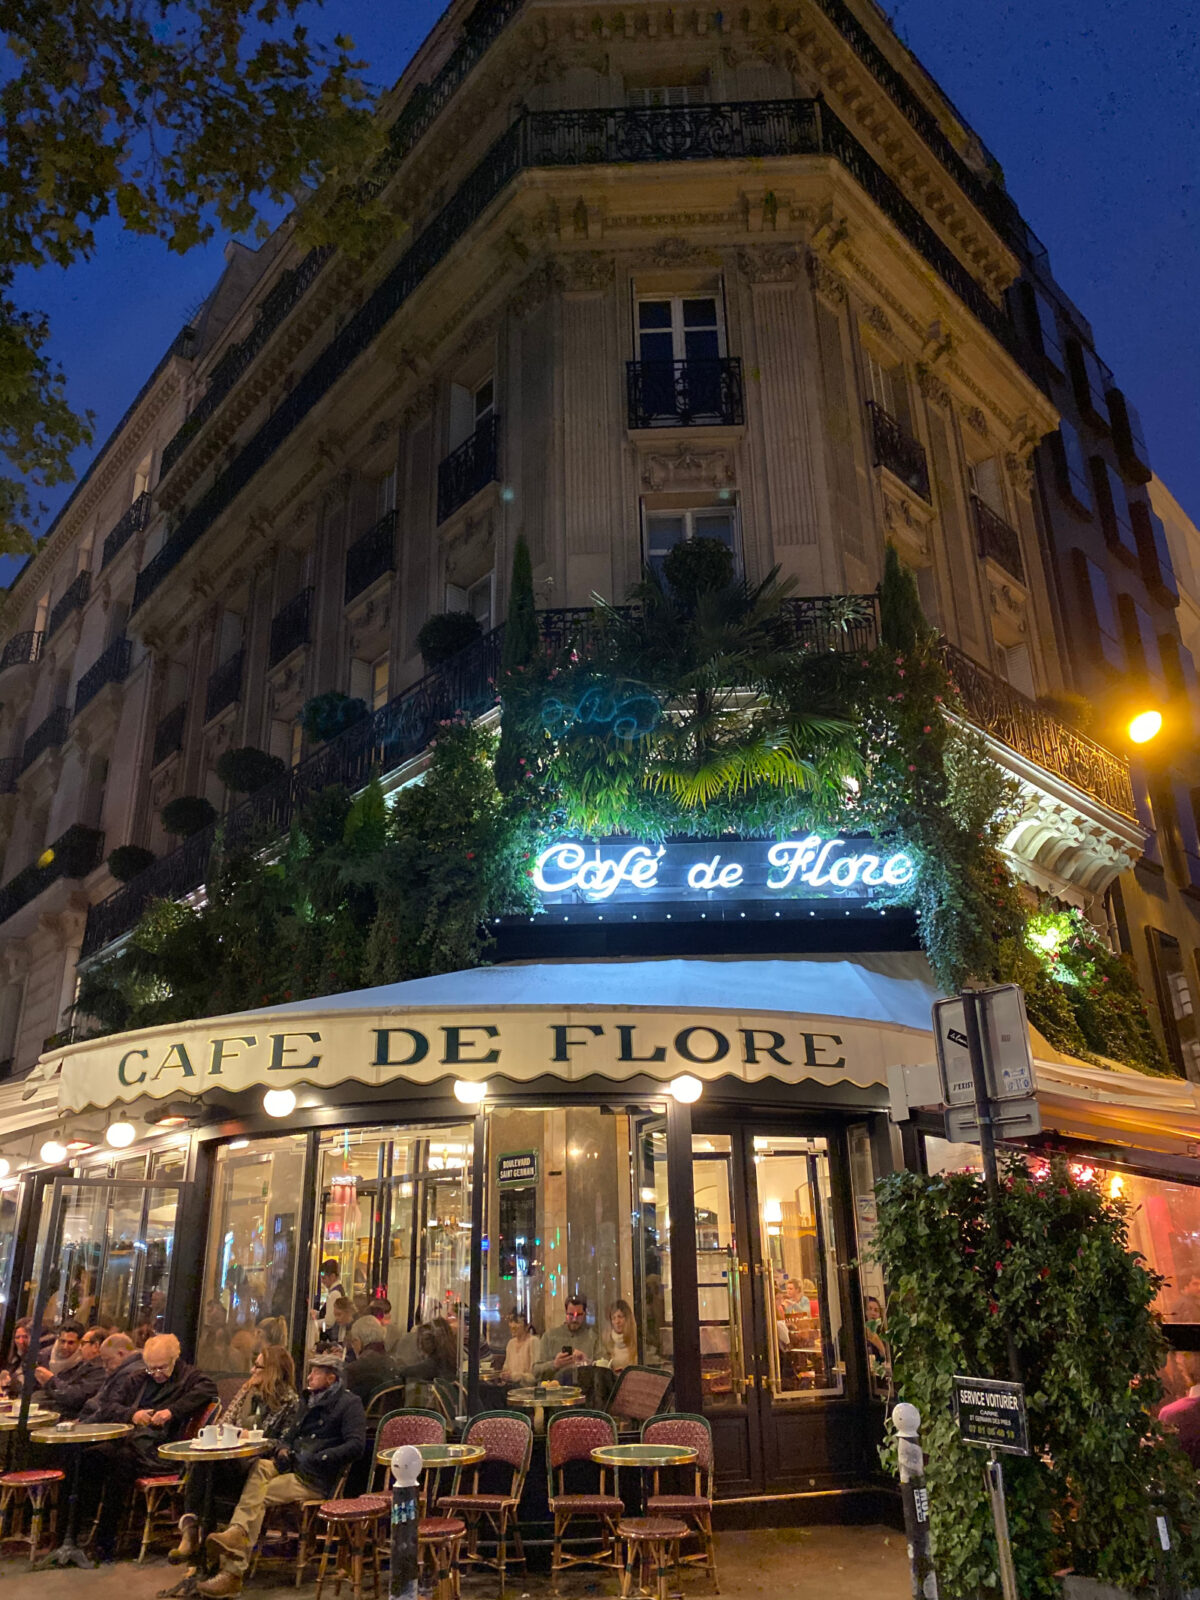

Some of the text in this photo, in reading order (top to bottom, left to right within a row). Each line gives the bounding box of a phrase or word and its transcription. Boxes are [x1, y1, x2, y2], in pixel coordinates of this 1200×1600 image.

[532, 835, 915, 899] Café de Flore
[117, 1024, 847, 1087] CAFE DE FLORE
[503, 1157, 530, 1168] BOULEVARD
[500, 1167, 534, 1179] SAINT GERMAIN
[960, 1390, 1018, 1410] SERVICE VOITURIER
